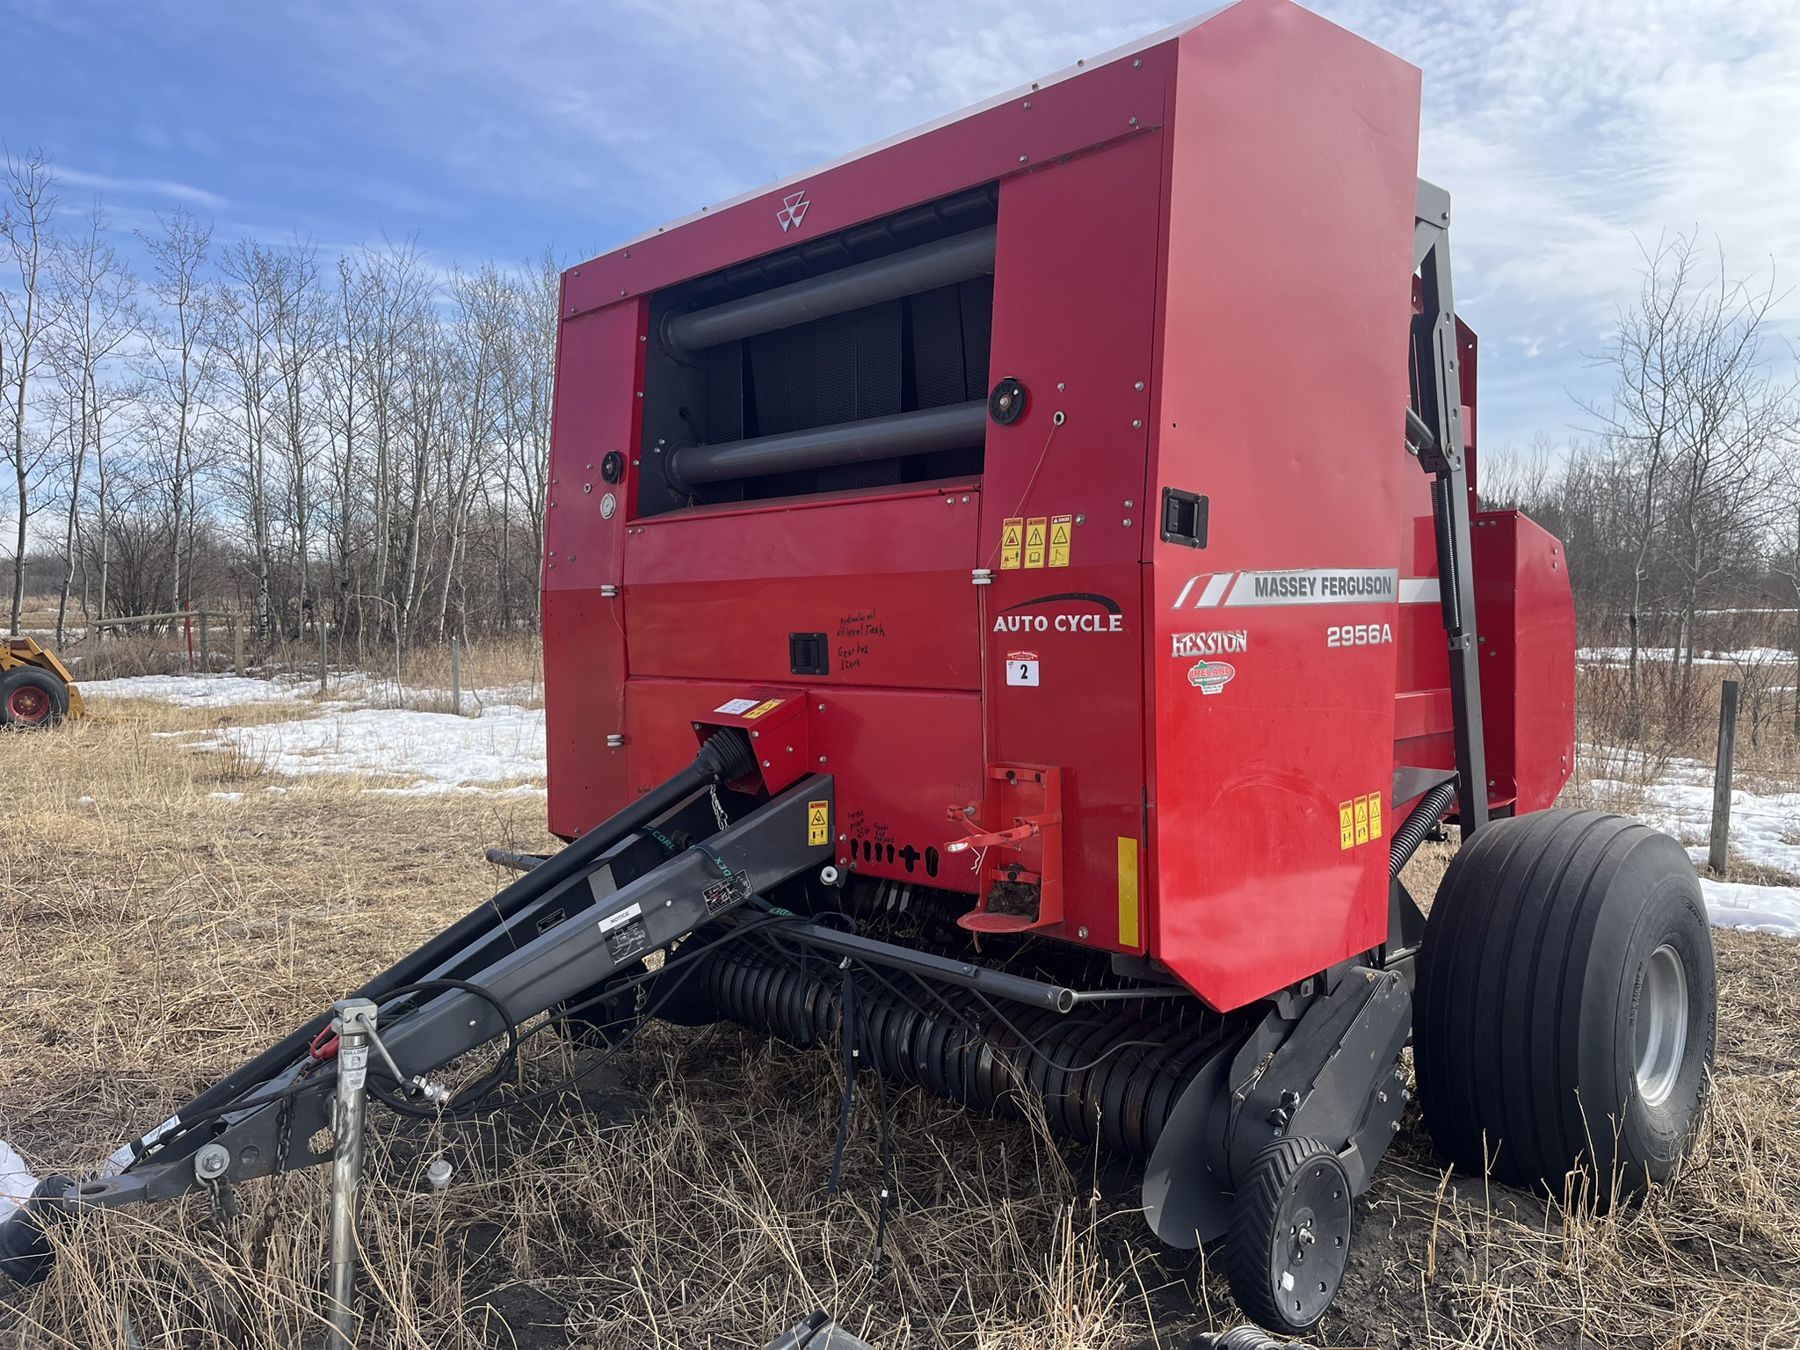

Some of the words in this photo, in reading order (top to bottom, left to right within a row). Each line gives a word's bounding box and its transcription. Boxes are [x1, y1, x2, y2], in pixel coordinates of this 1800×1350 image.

[1254, 576, 1317, 597] MASSEY
[1321, 576, 1392, 596] FERGUSON
[993, 615, 1048, 632] AUTO
[1054, 614, 1123, 632] CYCLE
[1327, 623, 1393, 648] 2956A
[1020, 663, 1028, 680] 2
[610, 911, 629, 923] NOTICE
